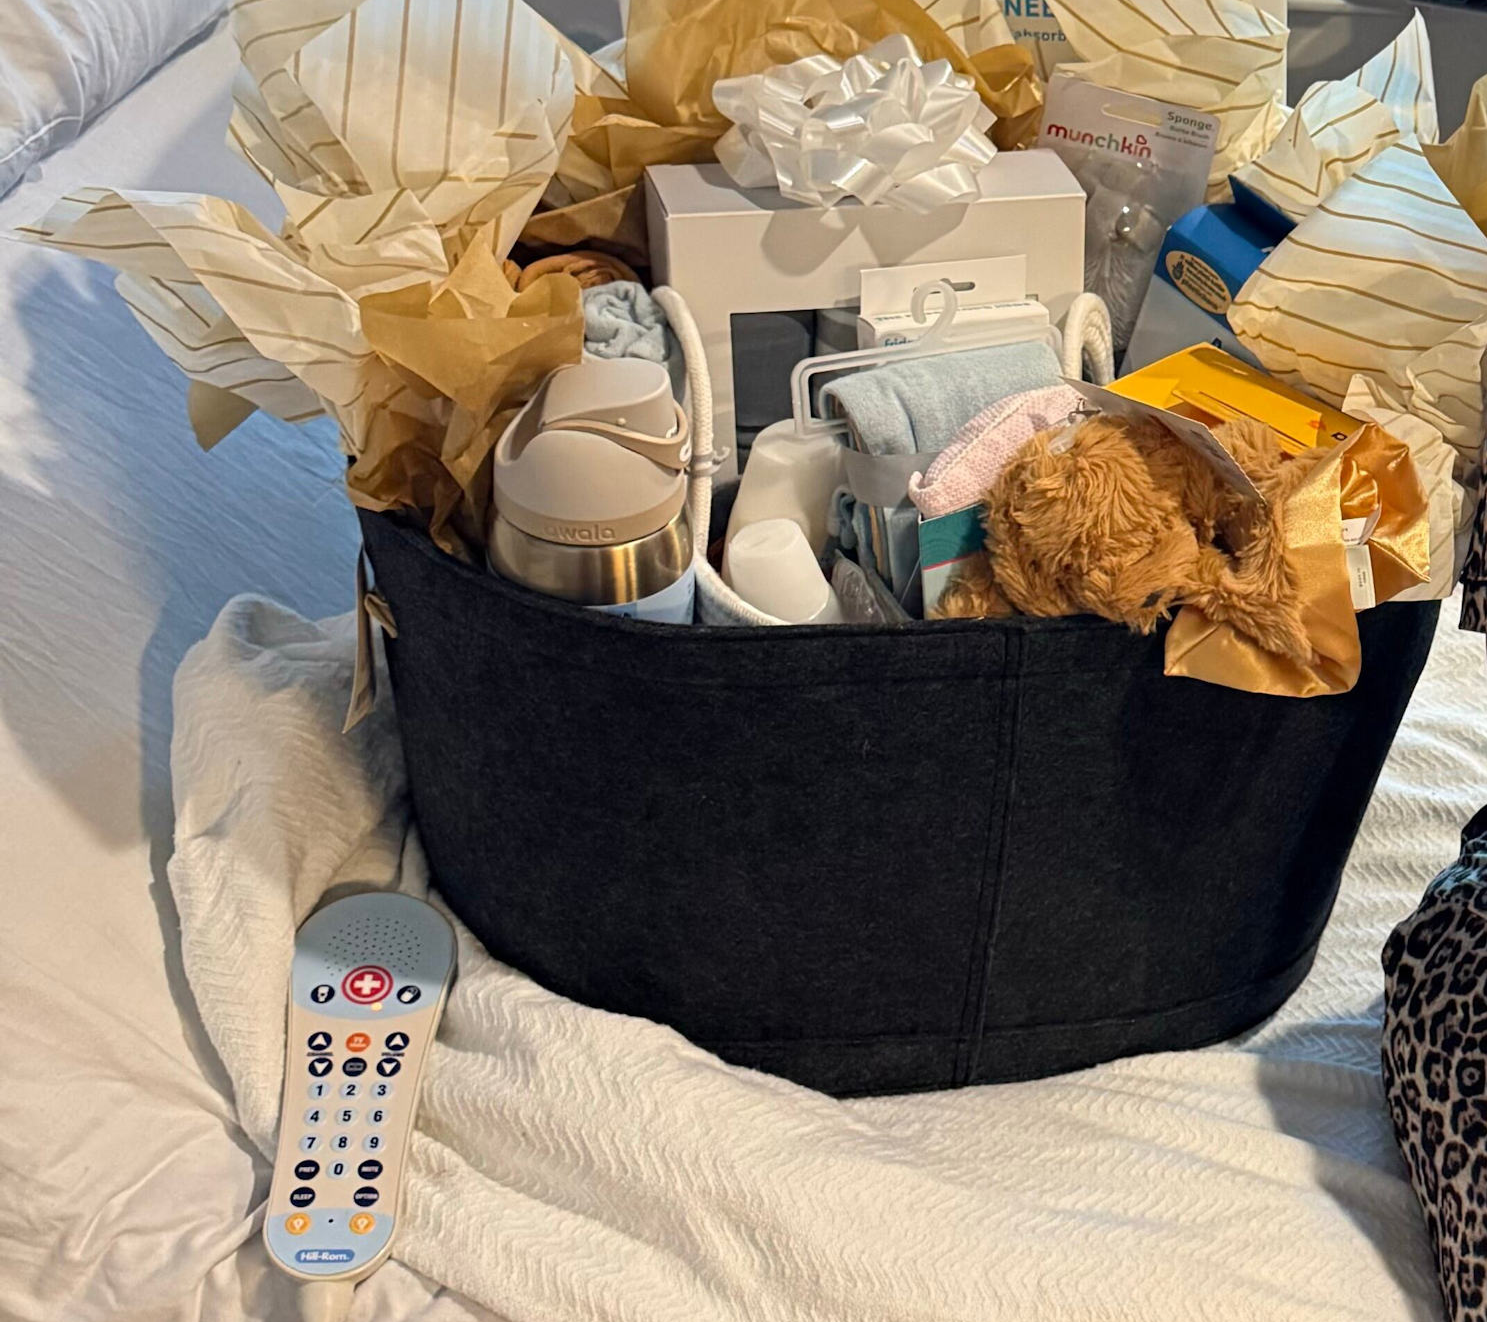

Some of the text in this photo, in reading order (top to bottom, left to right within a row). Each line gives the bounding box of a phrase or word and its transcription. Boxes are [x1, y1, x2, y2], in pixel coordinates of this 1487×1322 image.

[1047, 123, 1152, 159] munchkin
[316, 1084, 387, 1096] 1 2 3
[310, 1110, 383, 1122] 4 5 6
[307, 1136, 379, 1149] 7 8 9
[334, 1163, 344, 1175] 0
[300, 1251, 347, 1261] Hill-Rom
